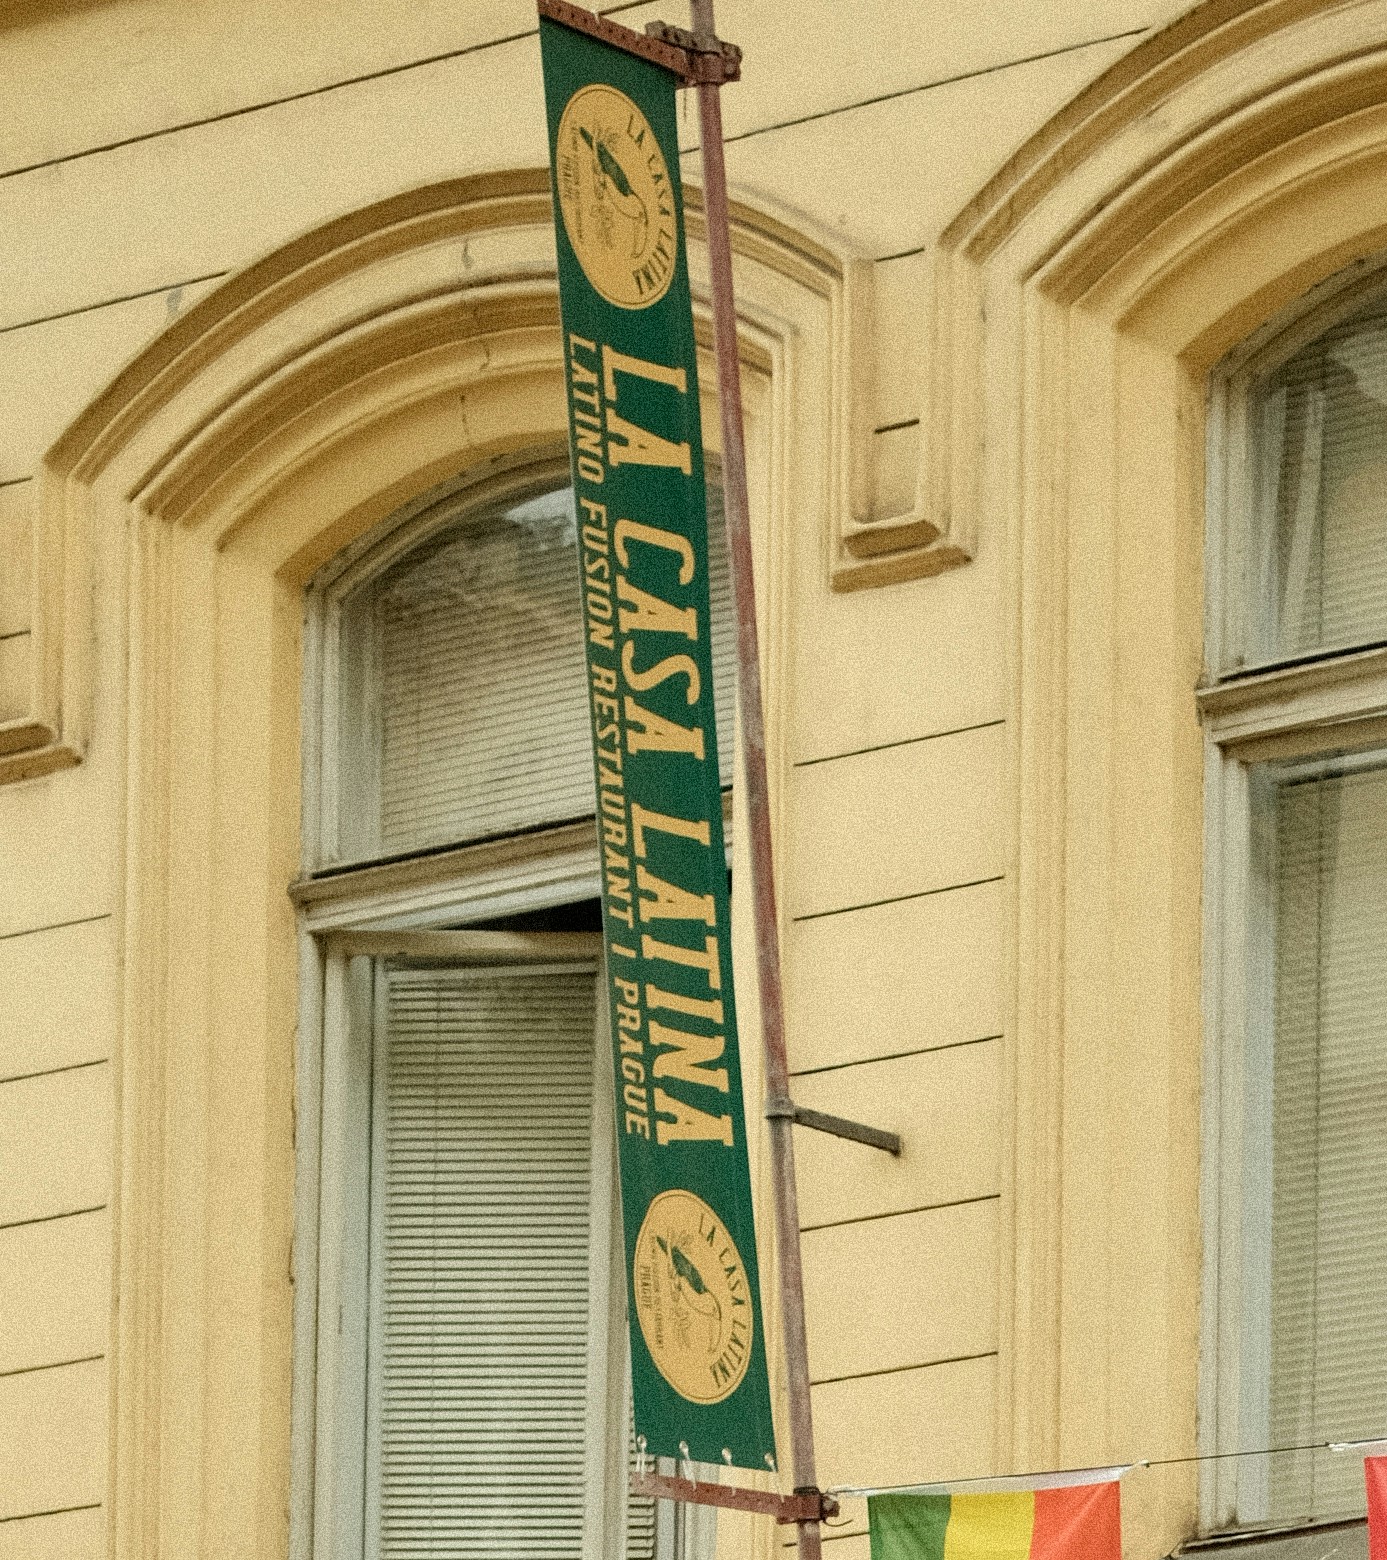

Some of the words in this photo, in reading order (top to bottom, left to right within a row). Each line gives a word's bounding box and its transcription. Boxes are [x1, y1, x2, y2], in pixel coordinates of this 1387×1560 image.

[568, 332, 606, 486] LATINO
[600, 343, 693, 477] LA
[579, 496, 617, 652] FUSION
[612, 517, 706, 760] CASA
[590, 664, 635, 929] RESTAURANT
[630, 802, 735, 1147] LATINA
[613, 976, 651, 1141] PRAGUE
[698, 1212, 718, 1247] LA
[718, 1247, 746, 1307] CASA
[709, 1318, 748, 1389] LATINA
